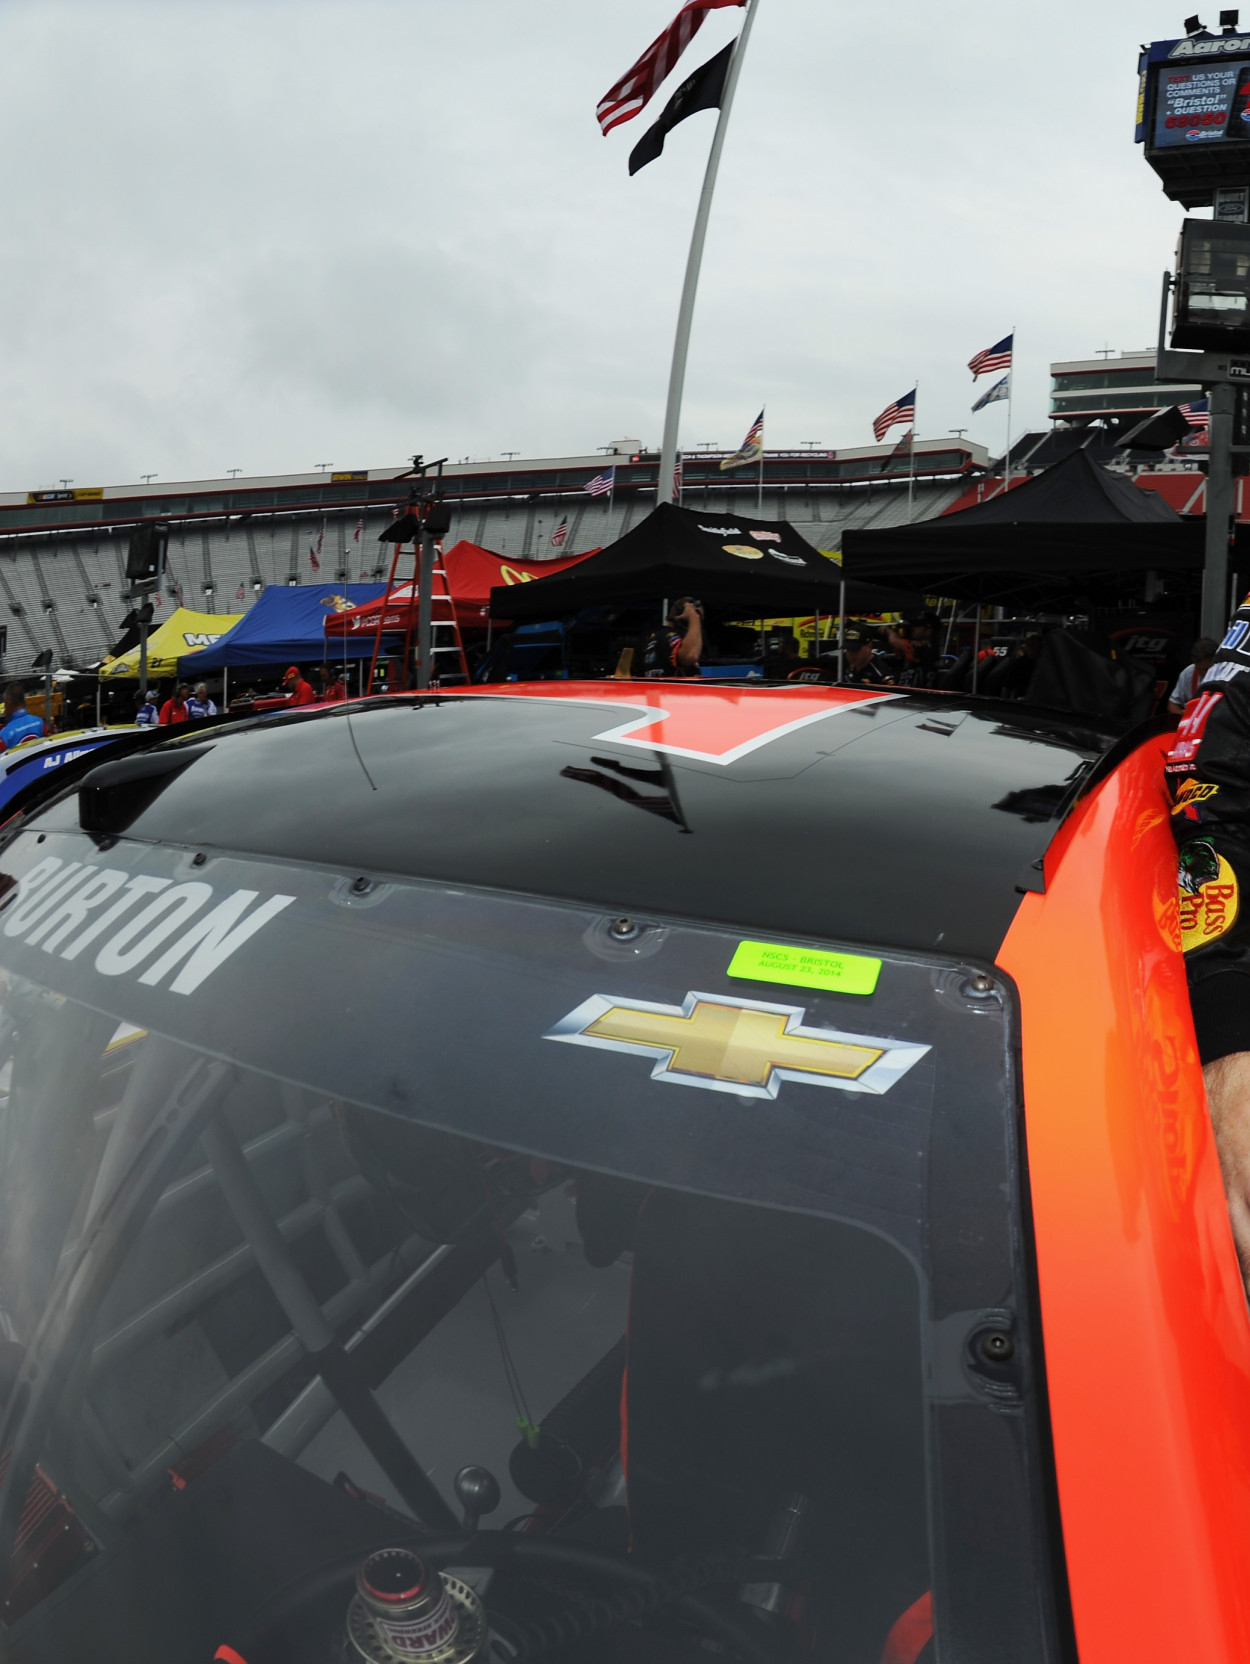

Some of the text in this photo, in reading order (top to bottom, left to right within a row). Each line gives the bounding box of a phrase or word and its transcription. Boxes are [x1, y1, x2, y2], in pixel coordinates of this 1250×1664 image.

[1206, 71, 1234, 80] YOUR
[1166, 80, 1220, 91] QUESTIONS
[1166, 87, 1220, 97] COMMENTS
[1174, 104, 1227, 115] QUESTION
[1165, 112, 1227, 129] 69050
[992, 646, 1009, 657] 55
[1124, 635, 1169, 652] jtg
[43, 754, 62, 769] AJ
[1180, 892, 1204, 931] Pro
[1203, 883, 1236, 937] Bass
[1, 856, 298, 996] BURTON
[758, 960, 842, 977] AUGUST 23, 2014
[762, 951, 844, 969] NSCS BRISTOL
